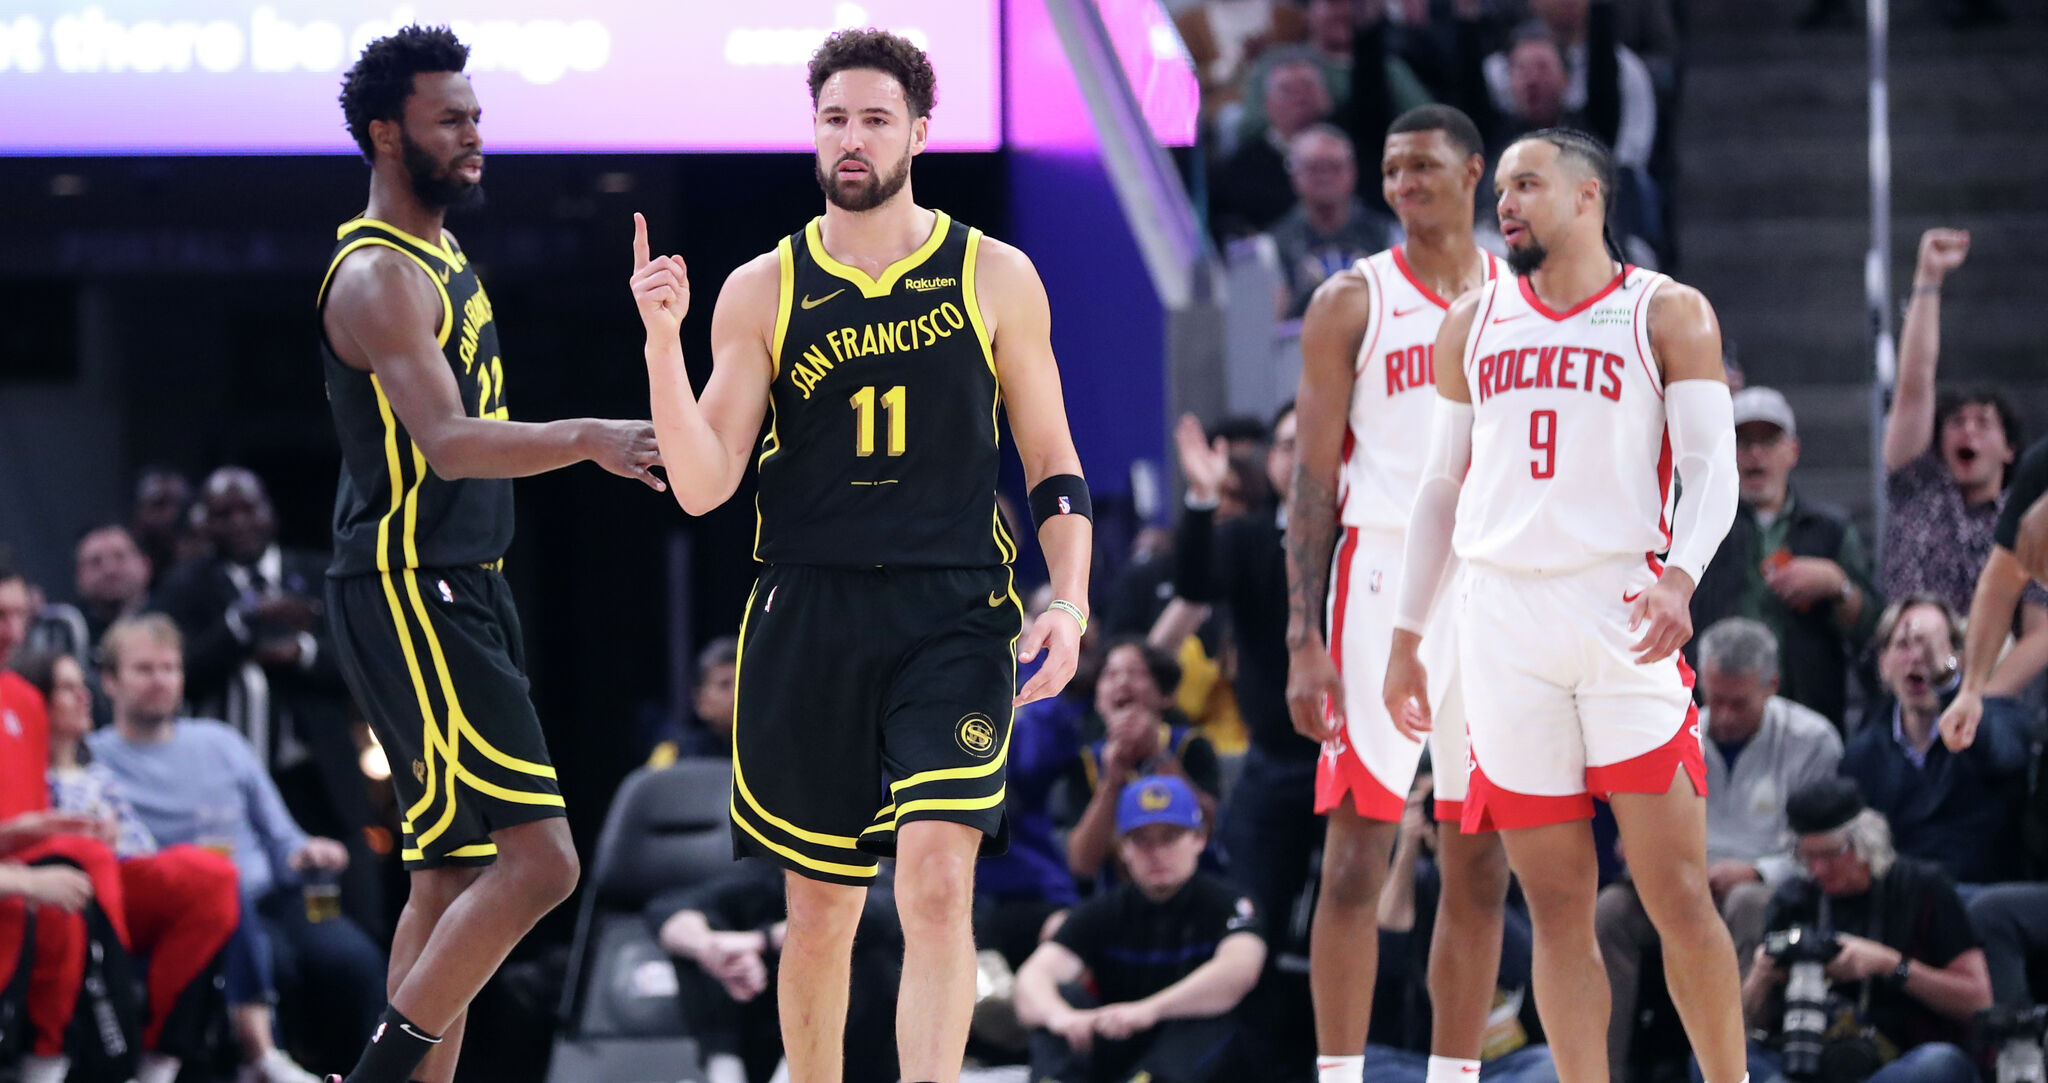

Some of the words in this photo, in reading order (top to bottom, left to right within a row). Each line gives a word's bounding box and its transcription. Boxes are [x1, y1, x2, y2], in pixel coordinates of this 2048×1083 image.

[250, 5, 344, 71] be
[905, 277, 957, 291] Rakuten
[790, 344, 834, 400] SAN
[826, 302, 965, 363] FRANCISCO
[1479, 346, 1625, 404] ROCKETS
[849, 386, 906, 457] 11
[1530, 410, 1557, 479] 9
